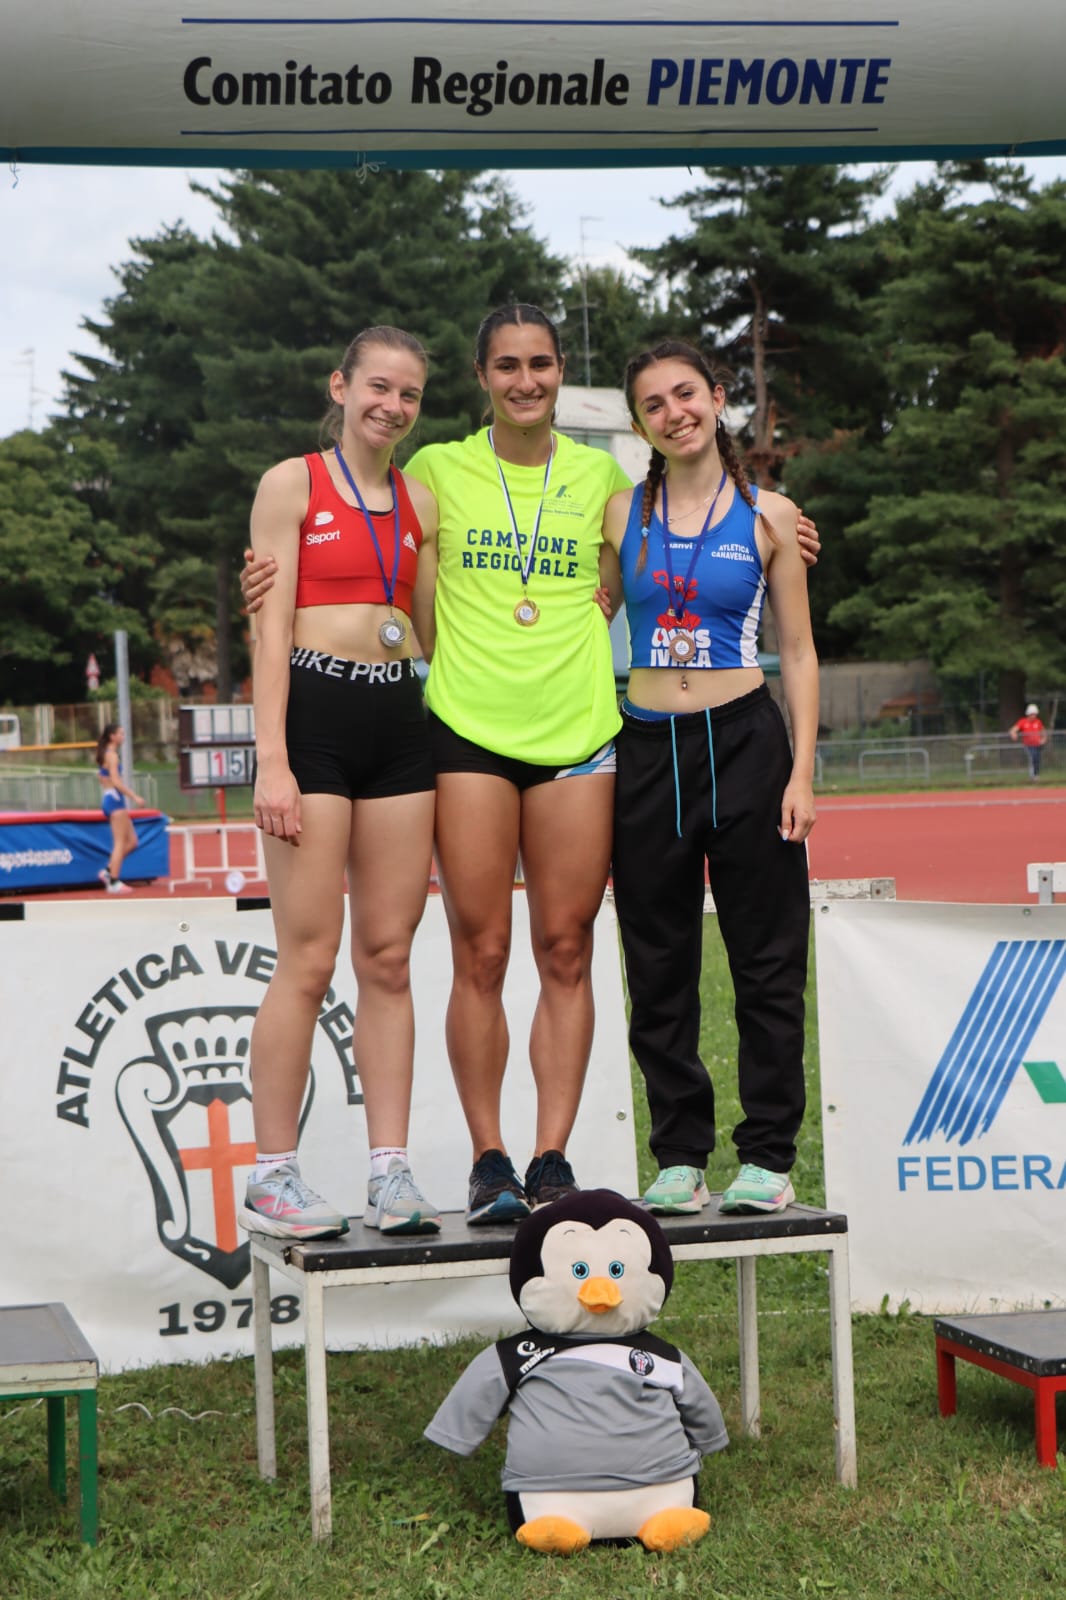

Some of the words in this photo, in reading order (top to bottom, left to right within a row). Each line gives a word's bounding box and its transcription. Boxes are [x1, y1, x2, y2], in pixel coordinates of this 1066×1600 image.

[183, 57, 392, 105] Comitato
[412, 56, 629, 116] Regionale
[647, 58, 892, 106] PIEMONTE
[306, 529, 340, 545] Sisport
[718, 543, 750, 554] ATLETICA
[350, 660, 402, 684] PRO
[56, 943, 204, 1129] ATLETICA
[897, 1155, 1066, 1191] FEDER
